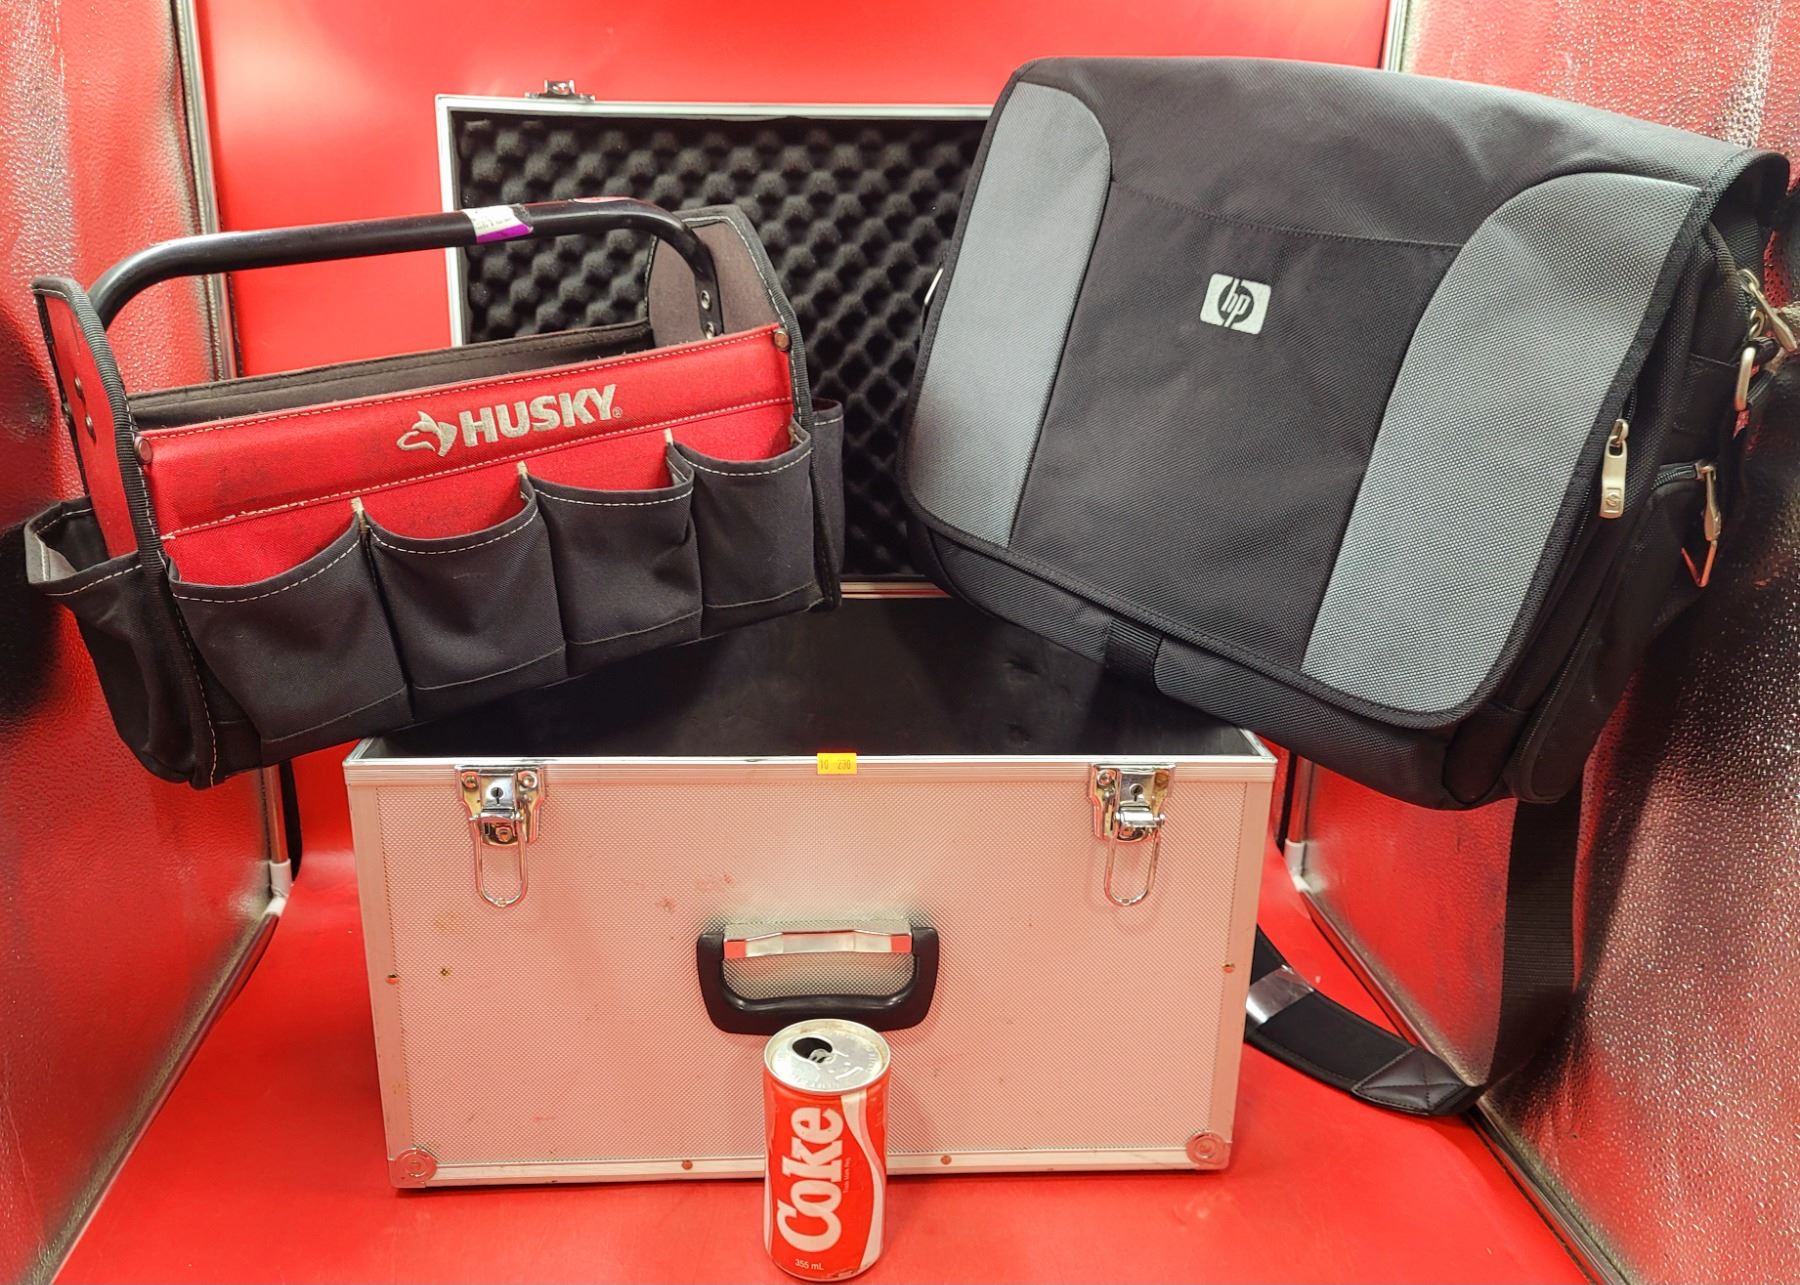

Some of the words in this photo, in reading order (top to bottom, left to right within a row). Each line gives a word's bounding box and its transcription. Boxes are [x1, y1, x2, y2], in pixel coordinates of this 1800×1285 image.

[458, 383, 617, 448] HUSKY
[777, 1106, 844, 1253] Coke
[795, 1258, 809, 1269] 355
